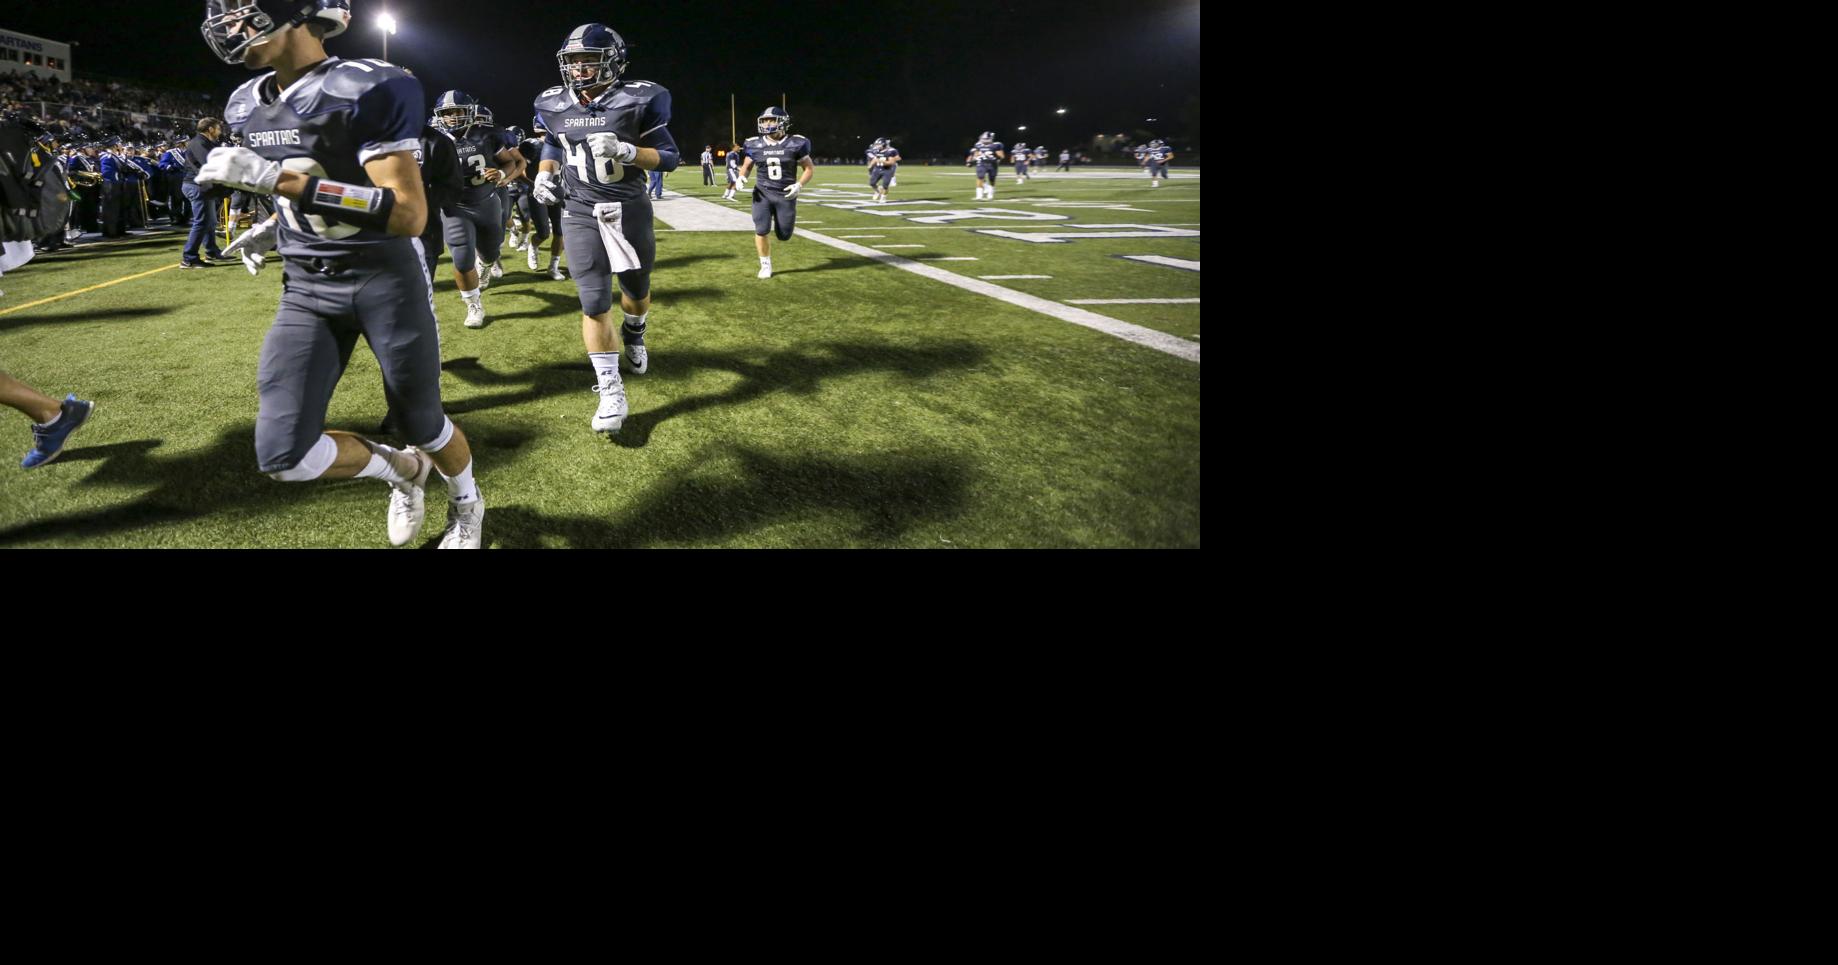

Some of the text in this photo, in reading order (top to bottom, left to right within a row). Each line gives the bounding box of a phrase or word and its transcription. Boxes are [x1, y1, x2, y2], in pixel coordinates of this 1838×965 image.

[563, 117, 606, 127] SPARTANS
[249, 129, 301, 148] SPARTANS
[459, 154, 486, 186] 3
[766, 157, 782, 180] 8
